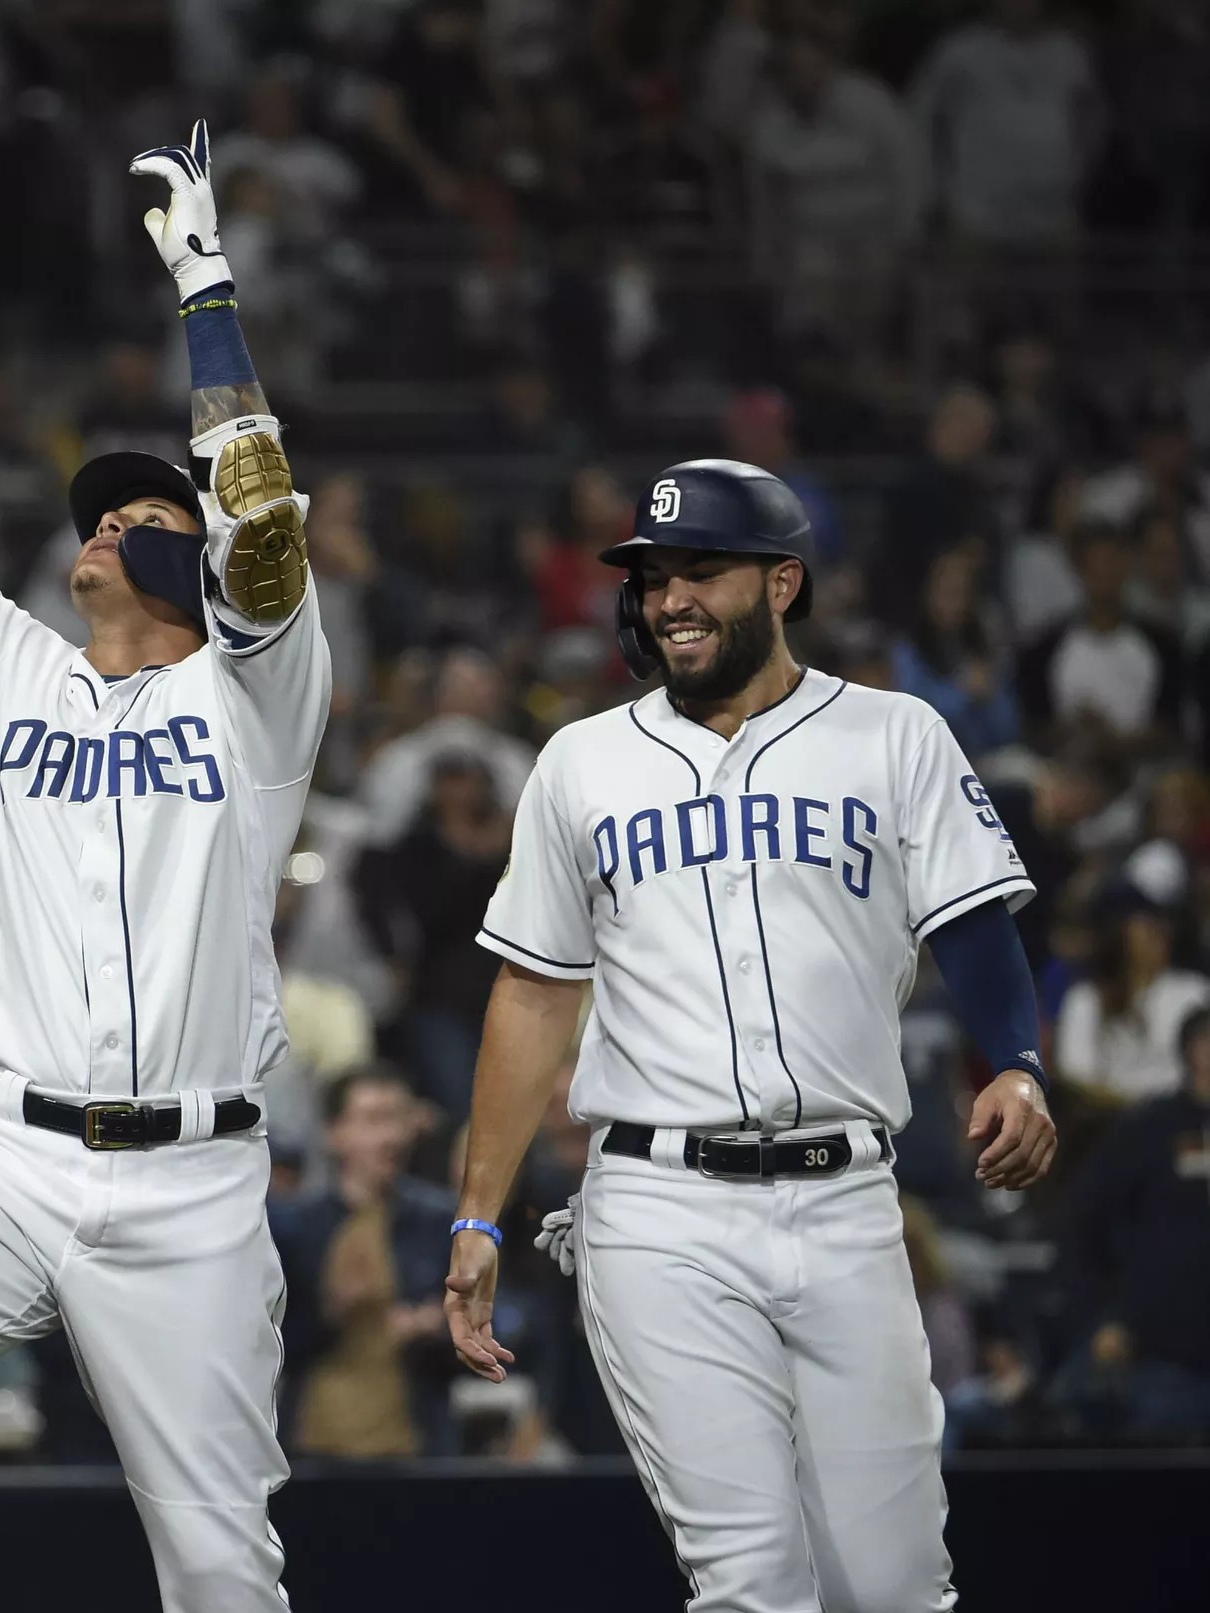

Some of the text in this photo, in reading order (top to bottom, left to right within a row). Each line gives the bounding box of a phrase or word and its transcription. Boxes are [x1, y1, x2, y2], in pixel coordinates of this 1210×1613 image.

[650, 478, 682, 524] SD
[0, 714, 227, 804] PADRES
[592, 792, 878, 916] PADRES
[804, 1148, 829, 1167] 30
